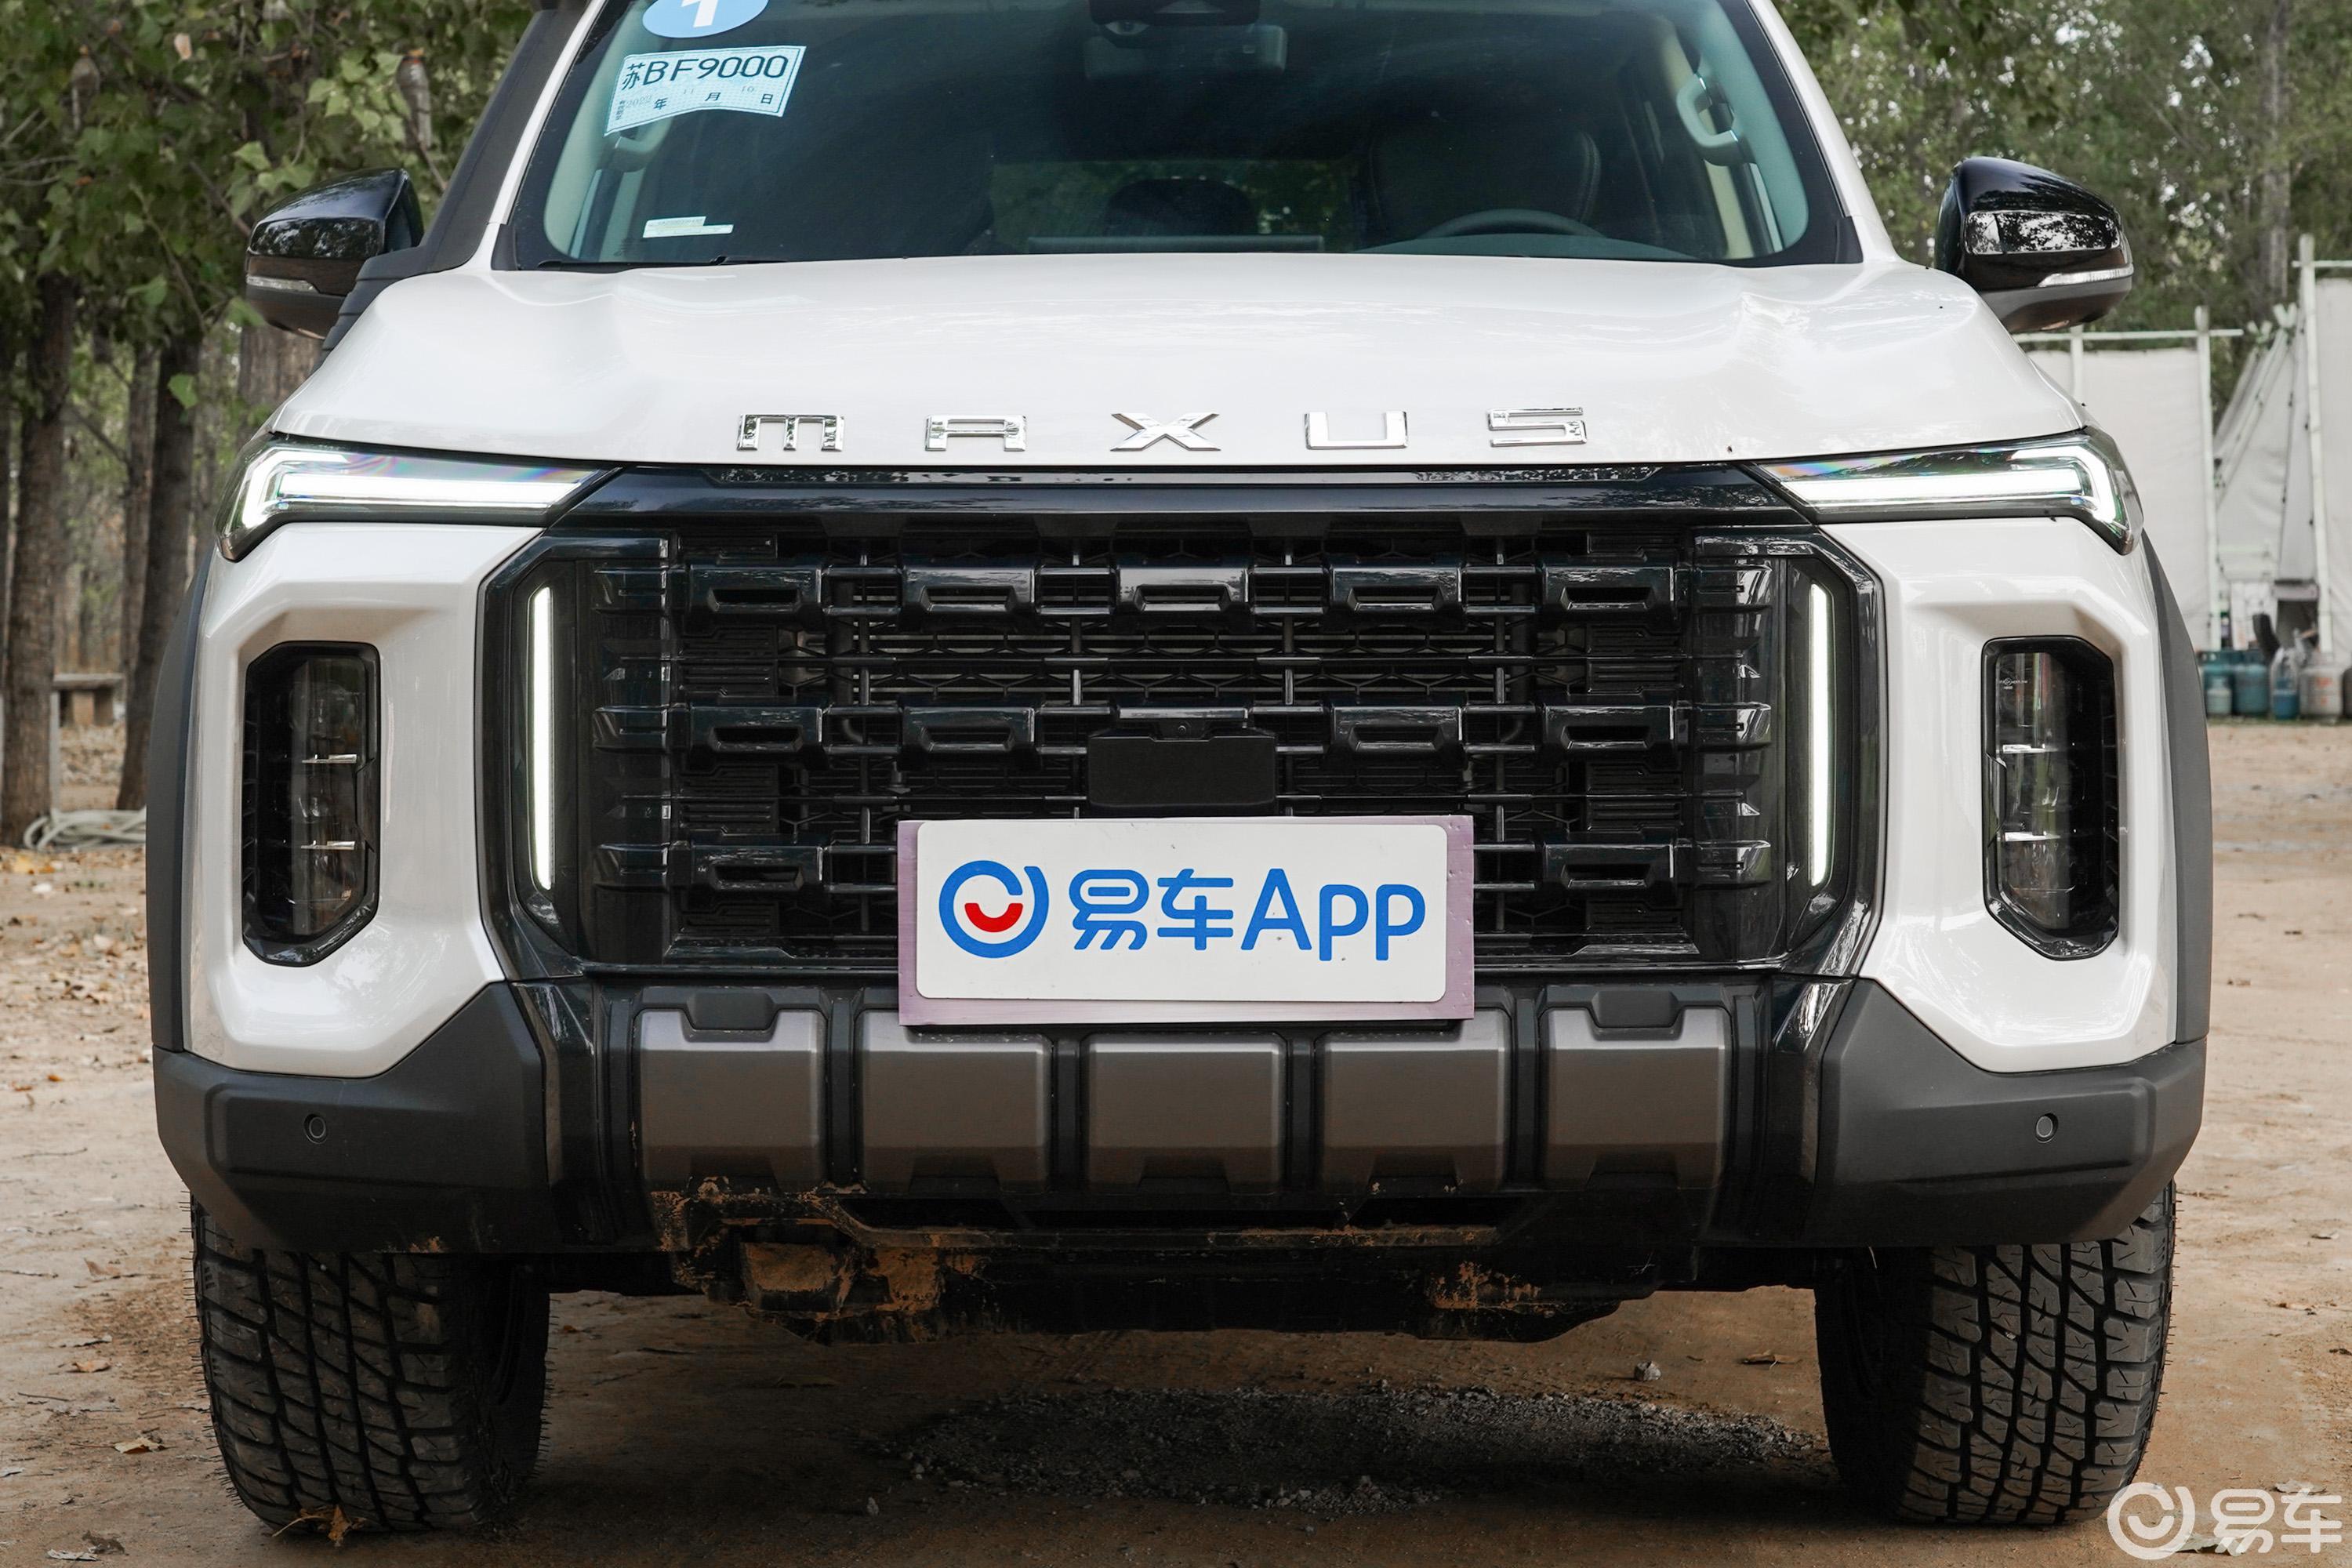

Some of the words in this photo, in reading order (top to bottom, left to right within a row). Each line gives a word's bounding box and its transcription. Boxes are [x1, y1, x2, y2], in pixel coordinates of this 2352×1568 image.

[621, 56, 789, 91] 苏BF9000
[737, 407, 1588, 452] MAXUS
[1069, 867, 1426, 961] 易车App
